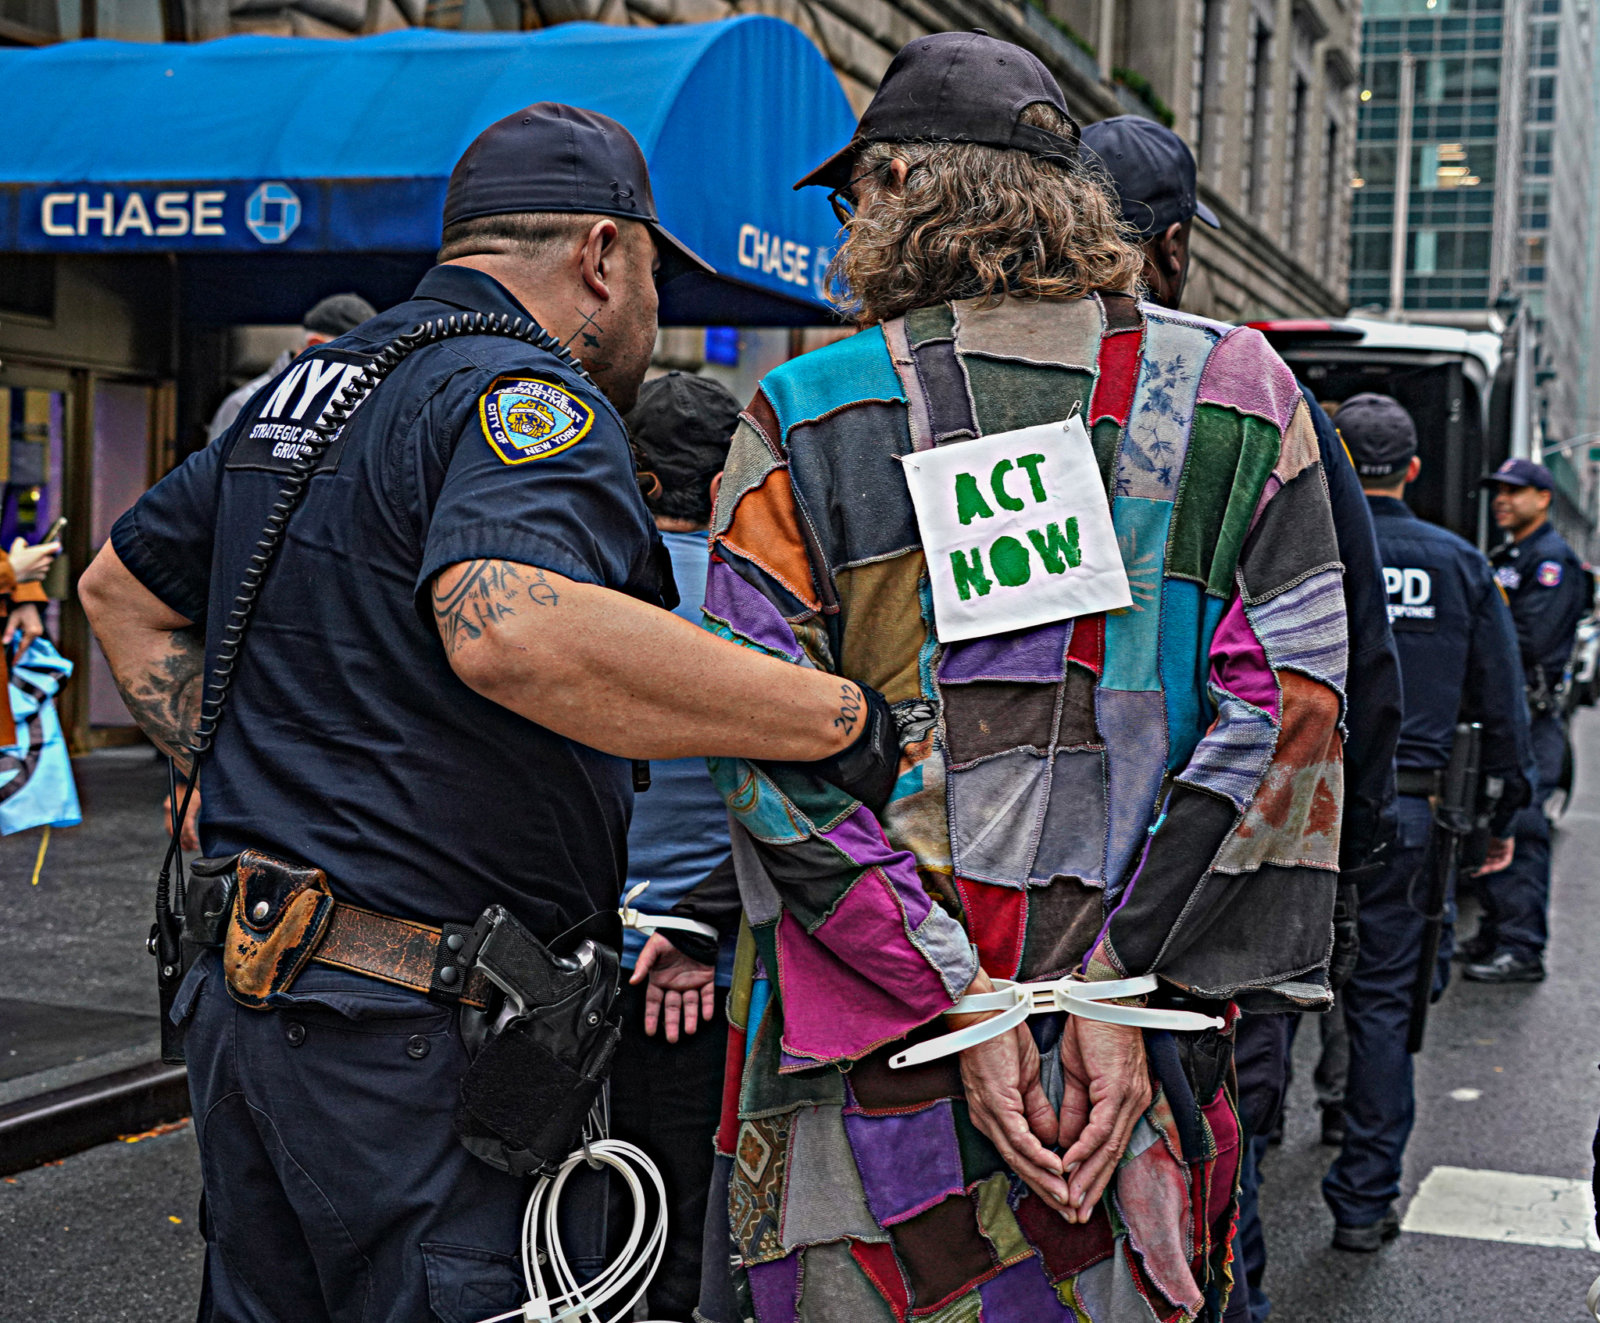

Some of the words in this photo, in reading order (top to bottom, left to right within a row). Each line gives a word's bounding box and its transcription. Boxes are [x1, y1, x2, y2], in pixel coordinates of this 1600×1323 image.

[41, 192, 227, 236] CHASE
[738, 223, 810, 287] CHASE
[259, 359, 382, 425] NYP
[493, 386, 584, 423] DEPARTMENT
[516, 381, 571, 404] POLICE
[249, 423, 302, 442] STRATEGIC
[487, 403, 501, 428] CITY
[495, 430, 509, 444] OF
[524, 441, 552, 455] NEW
[551, 426, 579, 445] YORK
[955, 453, 1047, 525] ACT
[949, 516, 1082, 601] NOW
[833, 684, 861, 736] 2002
